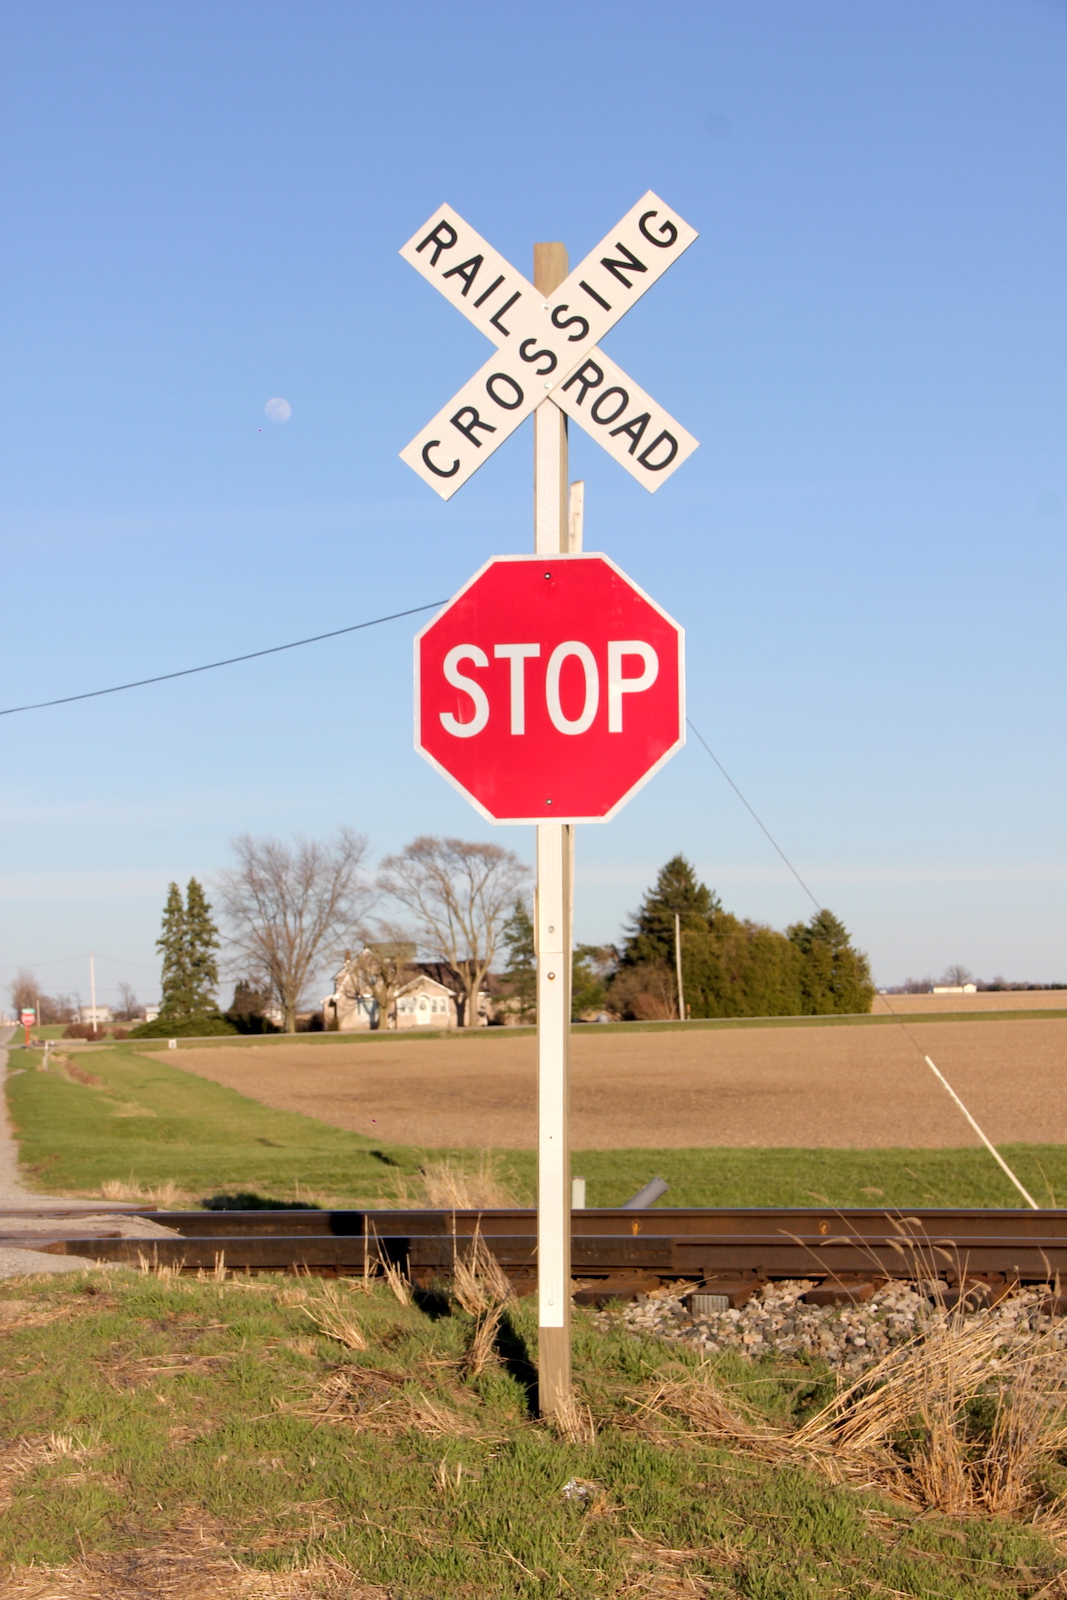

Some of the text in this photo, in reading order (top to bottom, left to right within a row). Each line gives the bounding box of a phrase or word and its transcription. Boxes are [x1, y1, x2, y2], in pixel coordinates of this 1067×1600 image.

[415, 219, 678, 472] RAIL ROAD
[421, 210, 678, 478] CROSSING
[439, 640, 660, 738] STOP
